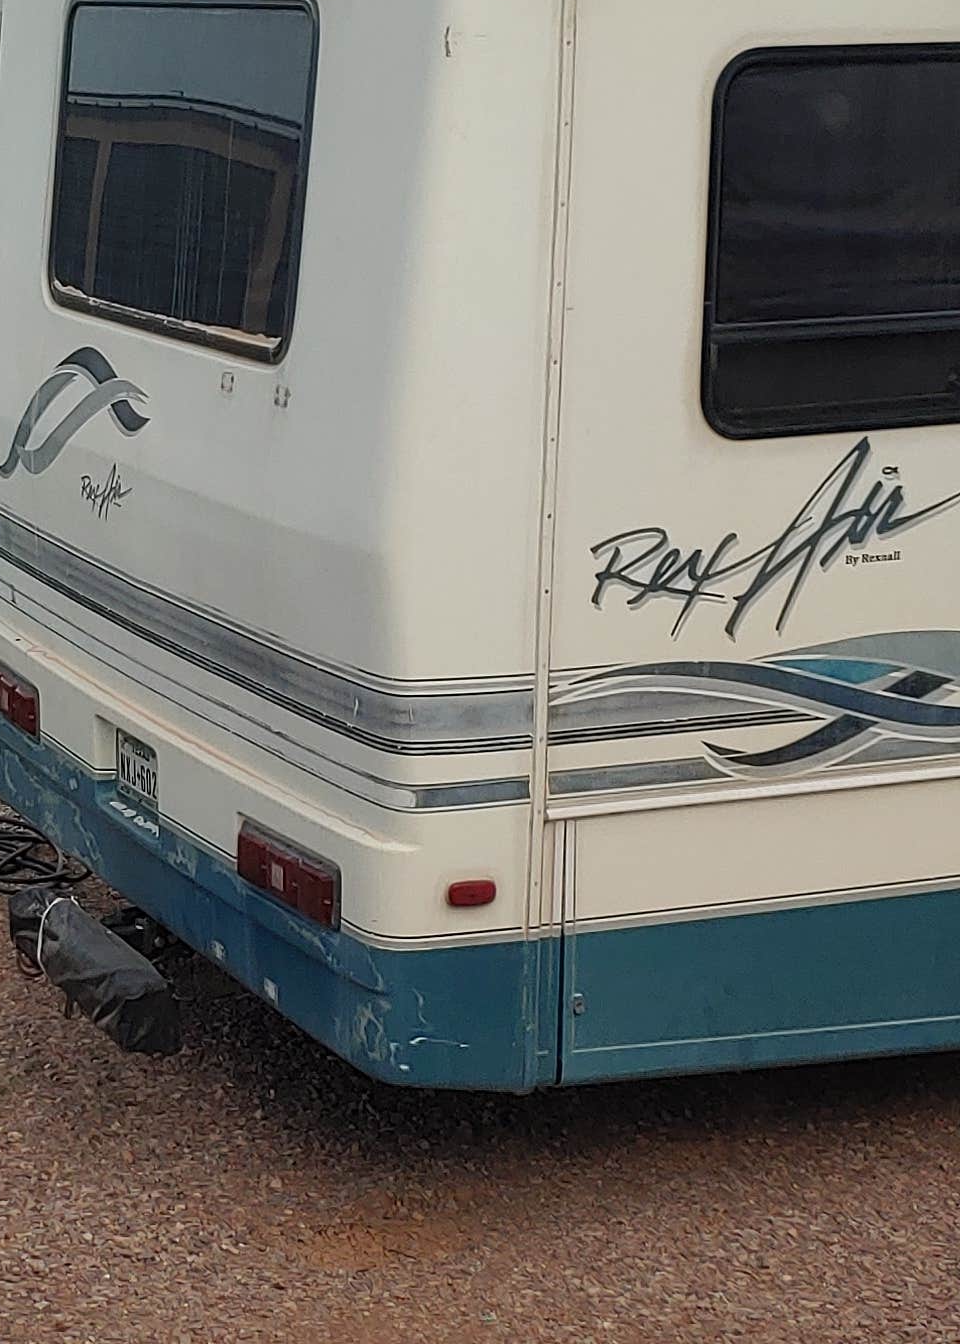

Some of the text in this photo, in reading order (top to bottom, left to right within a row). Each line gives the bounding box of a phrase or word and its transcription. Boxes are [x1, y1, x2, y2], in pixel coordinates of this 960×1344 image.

[590, 435, 960, 642] Rex Air
[845, 555, 860, 567] By
